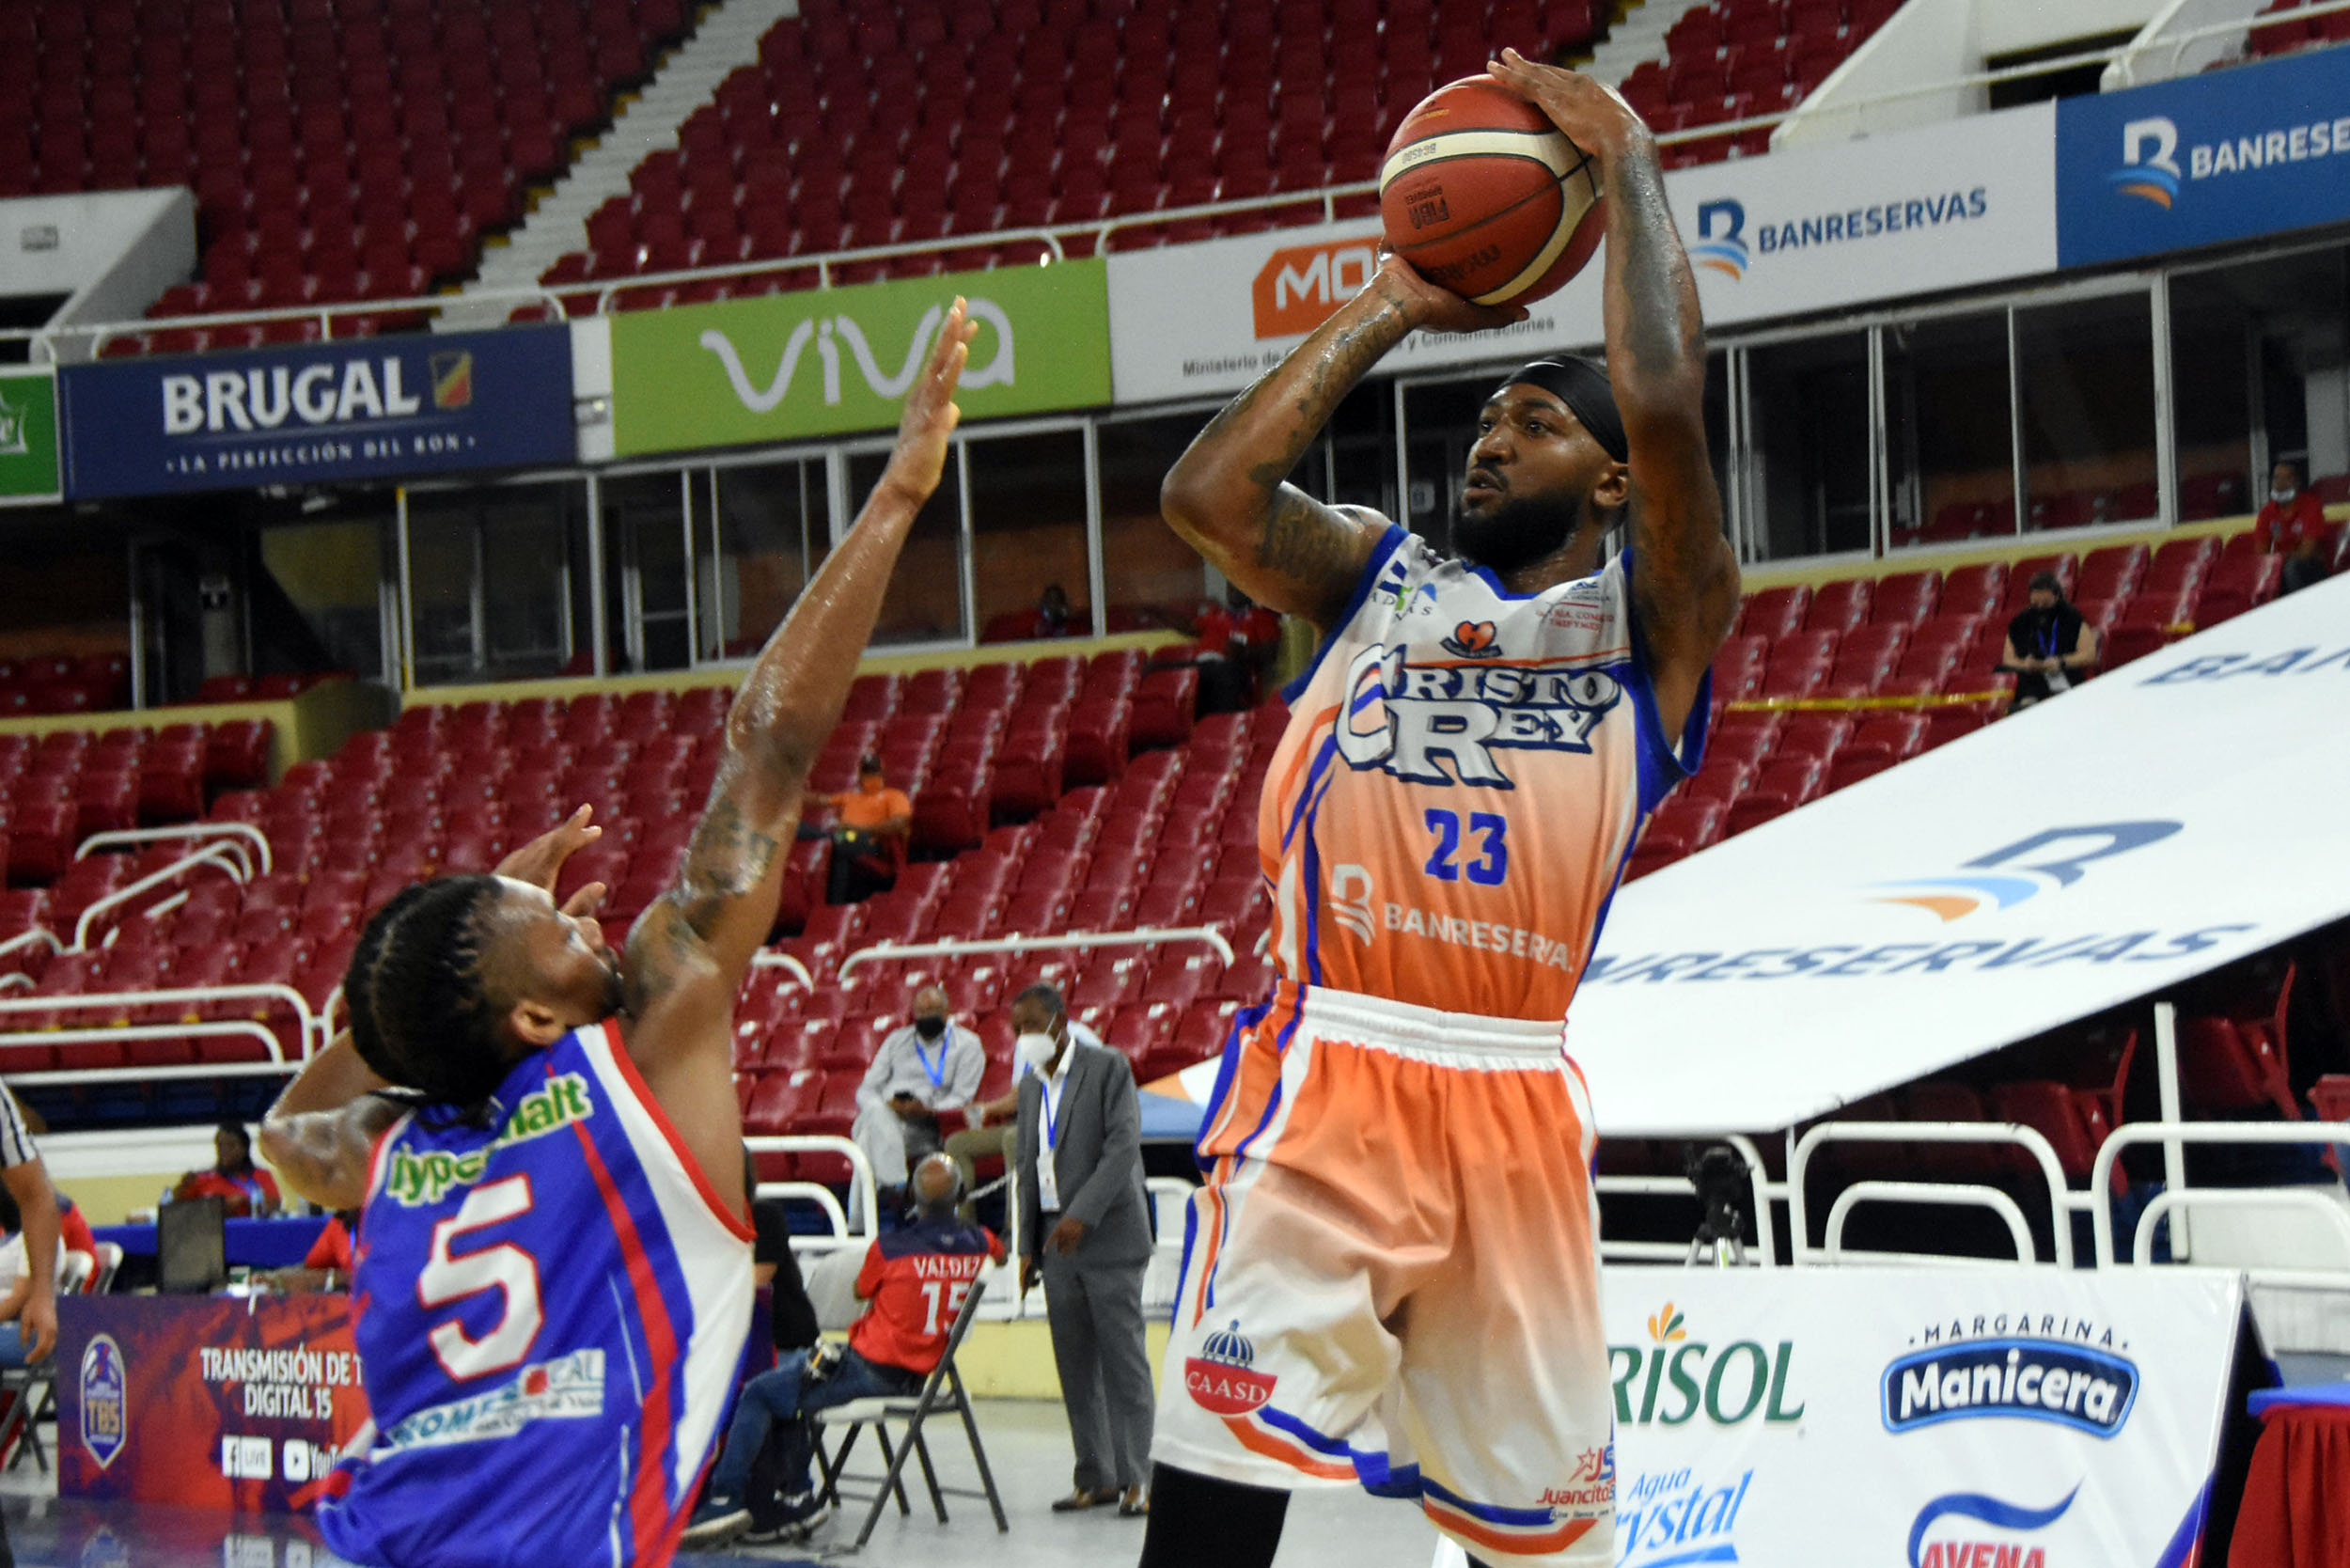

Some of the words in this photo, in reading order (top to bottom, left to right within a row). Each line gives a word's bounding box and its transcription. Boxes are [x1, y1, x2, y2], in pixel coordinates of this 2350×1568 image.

[1759, 189, 1987, 254] BANRESERVAS
[1183, 356, 1258, 377] Ministerio
[162, 357, 420, 435] BRUGAL
[363, 437, 402, 459] DEL
[1335, 642, 1622, 772] CRISTO
[1382, 698, 1596, 791] REY
[1424, 808, 1510, 886] 23
[417, 1171, 545, 1384] 5
[913, 1255, 980, 1278] VALDEZ
[1924, 1312, 2113, 1347] MARGARINA
[200, 1341, 322, 1385] TRANSMISIÓN
[326, 1350, 352, 1387] DE
[1186, 1371, 1267, 1403] CAASD
[1900, 1348, 2118, 1423] Manicera
[244, 1383, 313, 1419] DIGITAL
[315, 1387, 334, 1420] 15
[1627, 1466, 1692, 1504] Agua
